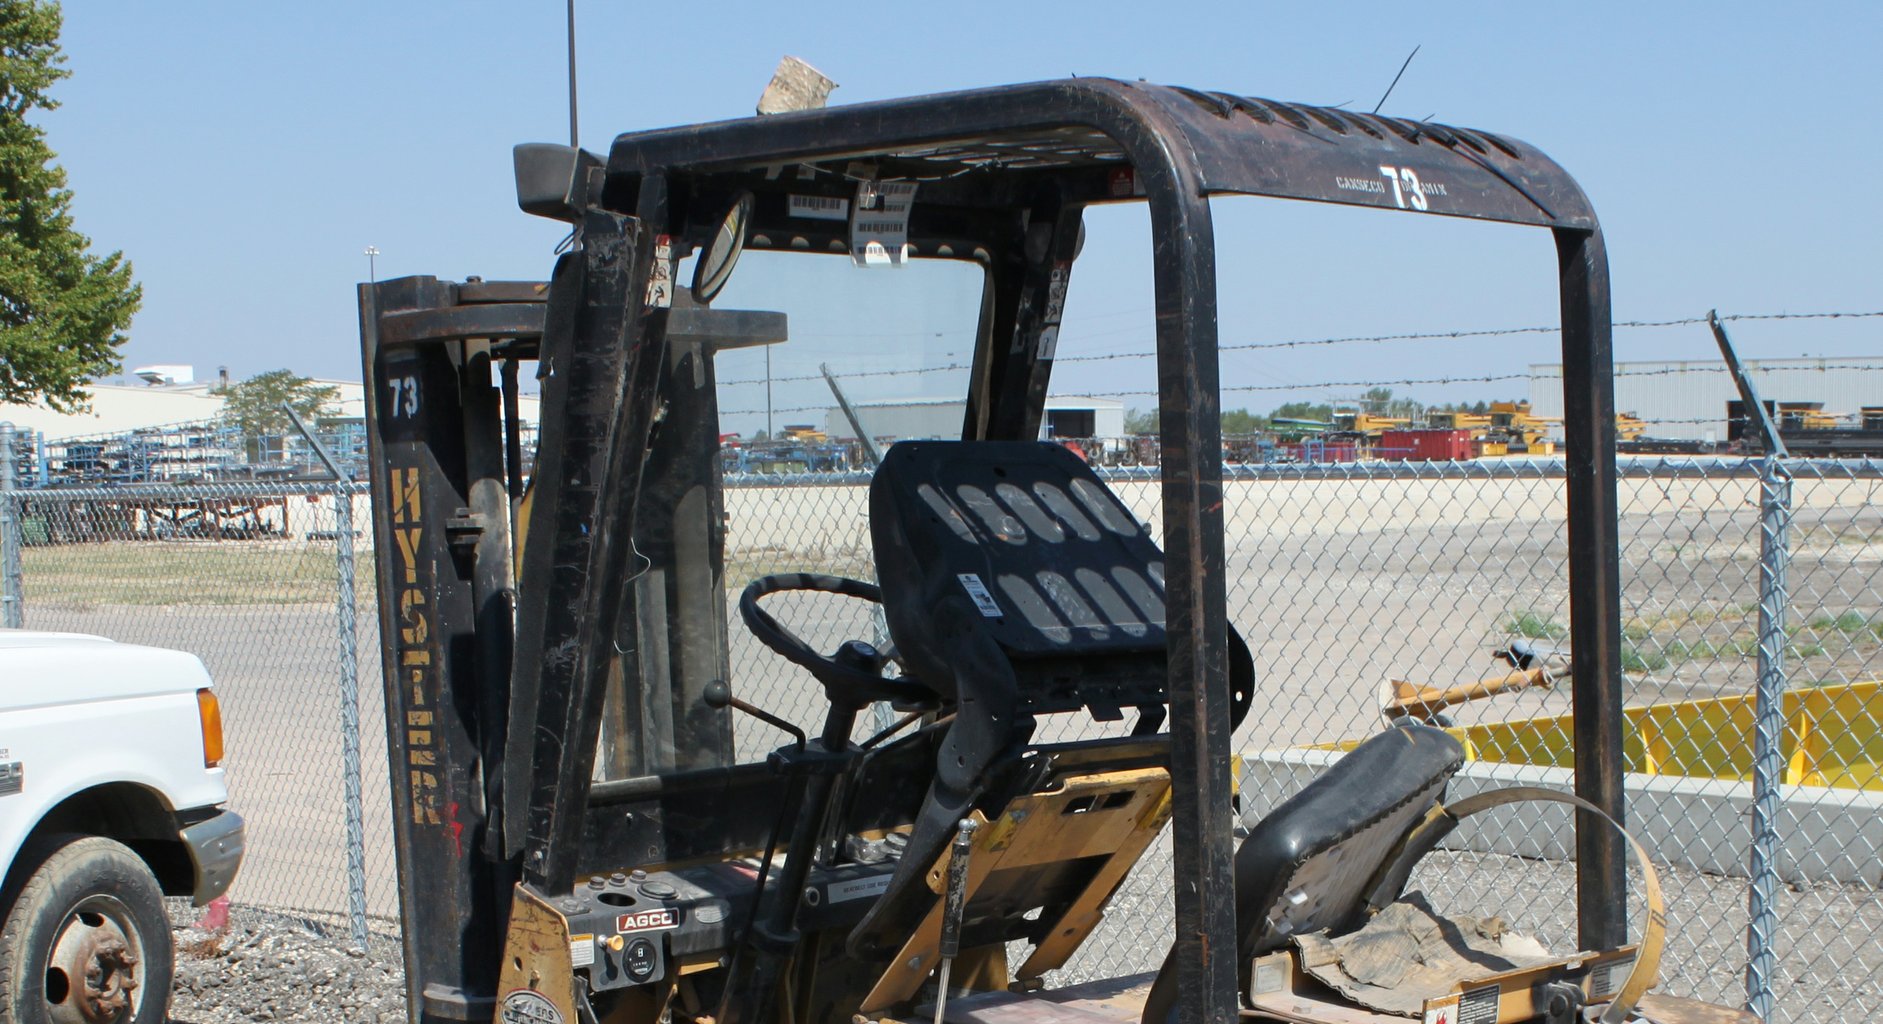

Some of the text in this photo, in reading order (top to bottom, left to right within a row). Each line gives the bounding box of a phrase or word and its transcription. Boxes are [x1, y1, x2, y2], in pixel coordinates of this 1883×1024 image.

[1379, 166, 1428, 211] 73
[389, 376, 418, 419] 73
[391, 467, 442, 825] HYSTER
[623, 912, 673, 930] AGCO
